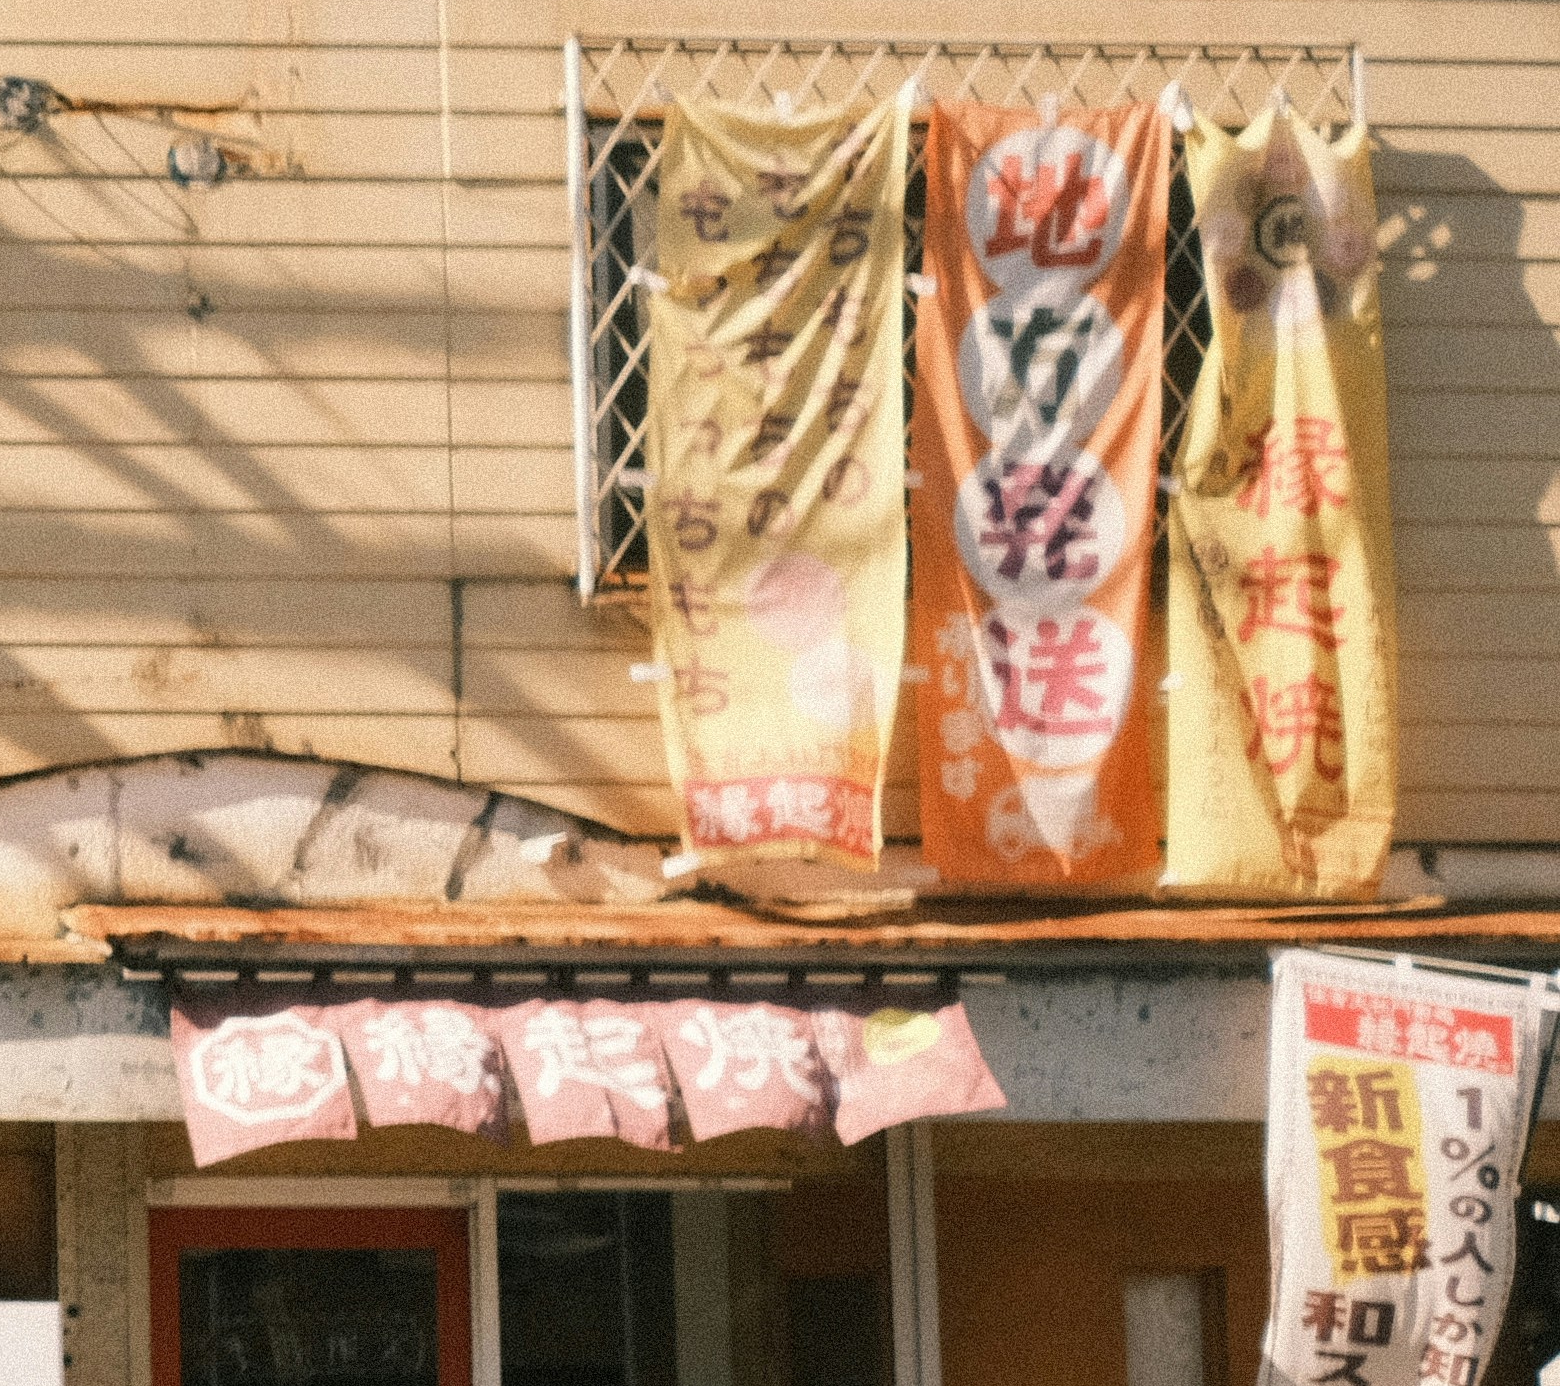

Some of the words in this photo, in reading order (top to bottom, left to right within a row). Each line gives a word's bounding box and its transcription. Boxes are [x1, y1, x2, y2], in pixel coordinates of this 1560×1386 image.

[978, 151, 1115, 737] 地方発送
[1234, 415, 1350, 785] 縁起焼
[1306, 1068, 1432, 1277] 新食感
